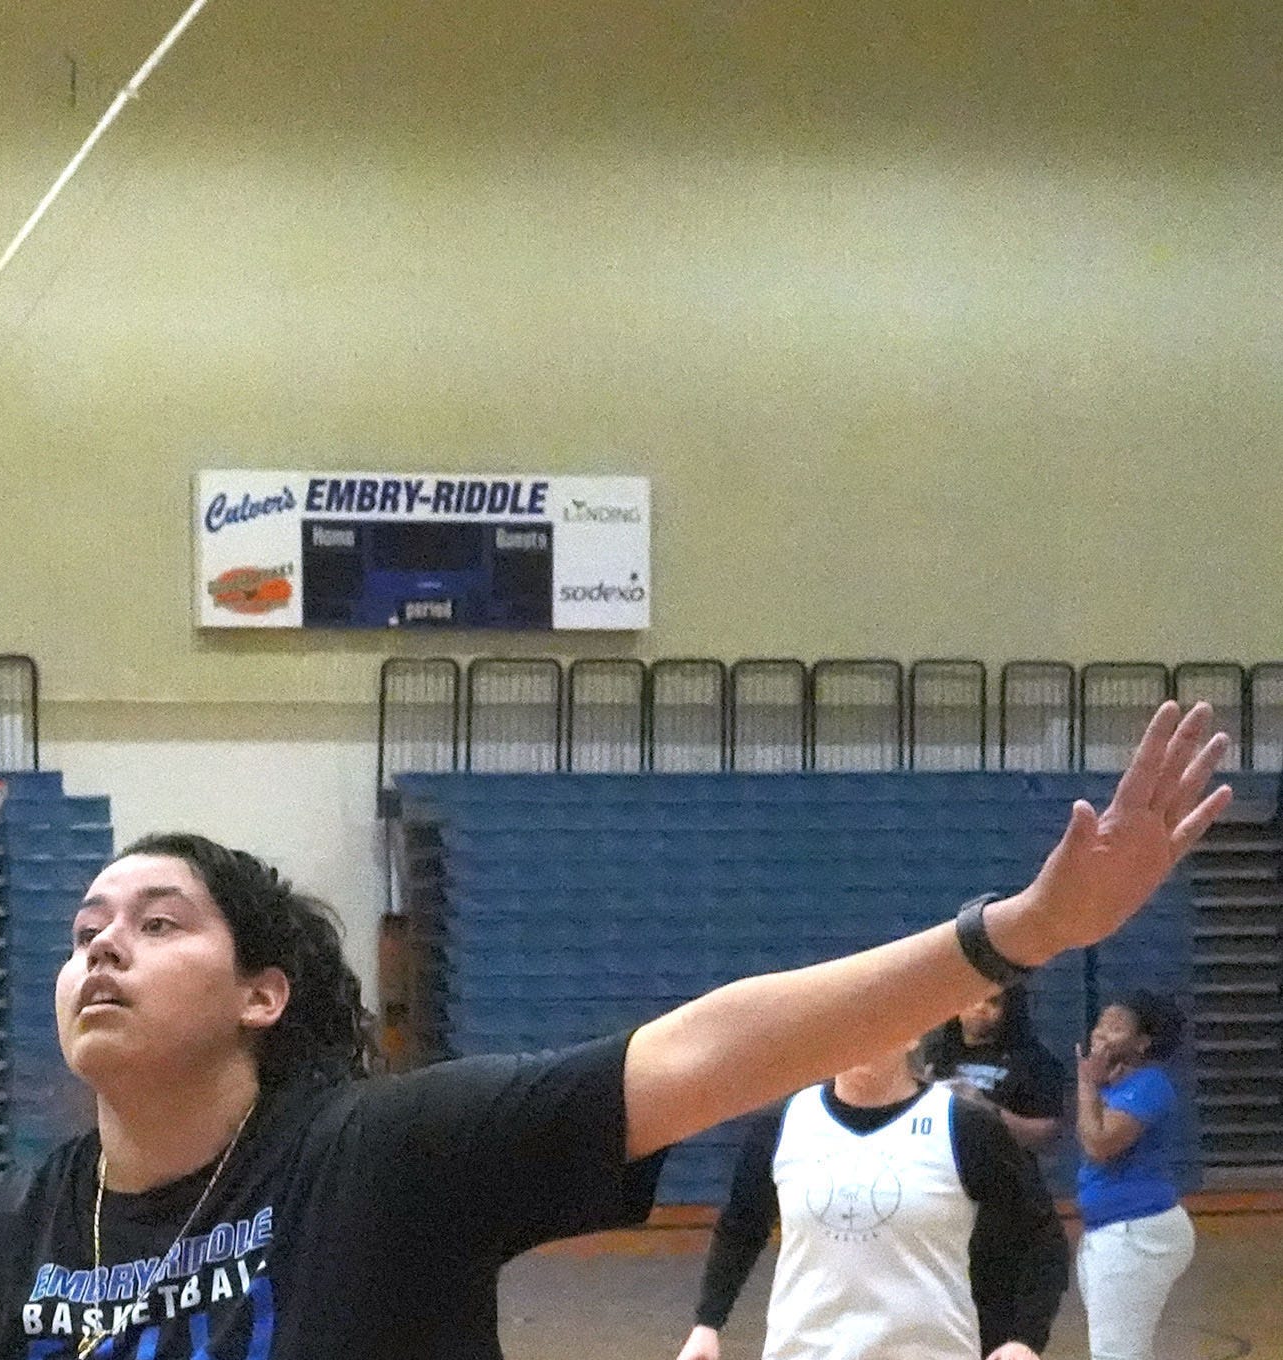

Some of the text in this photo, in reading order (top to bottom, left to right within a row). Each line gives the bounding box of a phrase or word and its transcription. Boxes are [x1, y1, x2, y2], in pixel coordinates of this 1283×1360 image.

[305, 478, 550, 516] EMBRY-RIDDLE
[910, 1116, 933, 1136] 10
[22, 1260, 267, 1337] BASKETBAL
